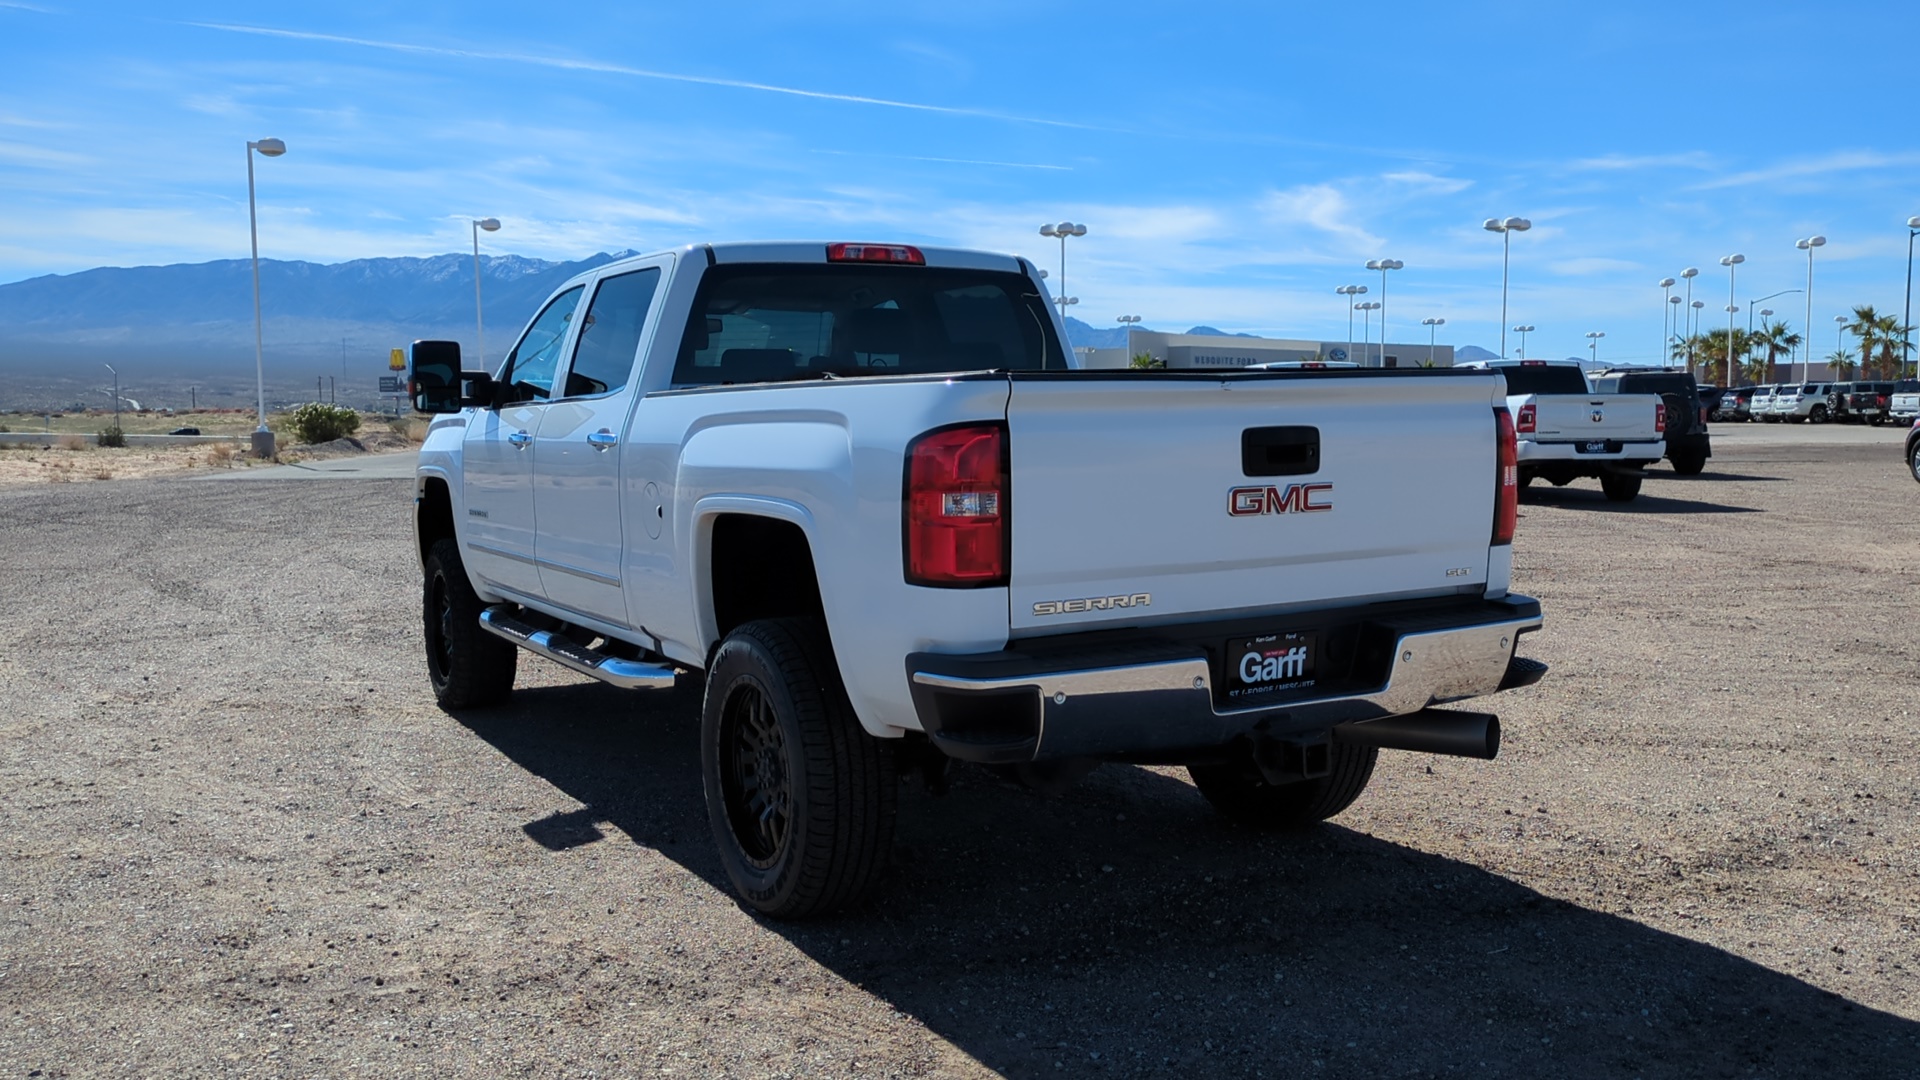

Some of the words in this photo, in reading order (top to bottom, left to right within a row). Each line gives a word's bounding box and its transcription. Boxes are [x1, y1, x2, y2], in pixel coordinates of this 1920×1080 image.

[1237, 357, 1257, 365] FORD
[1228, 482, 1333, 516] GMC
[1033, 593, 1151, 616] SIERRA
[1240, 646, 1307, 683] Garff
